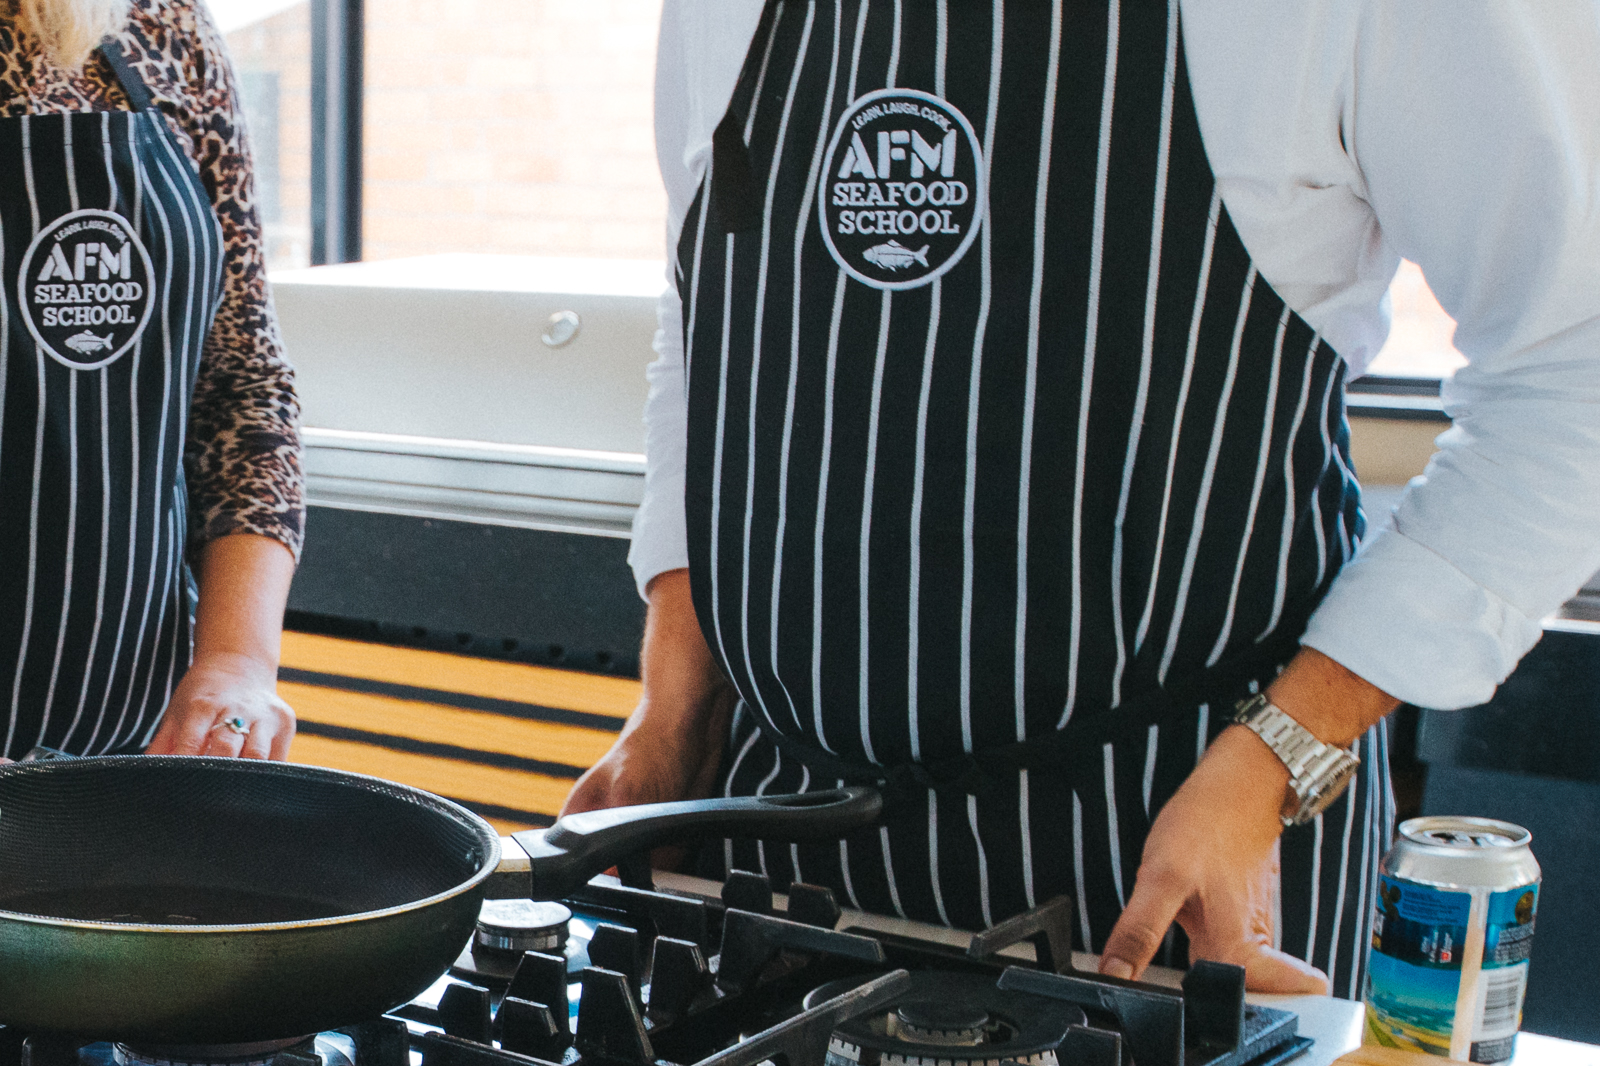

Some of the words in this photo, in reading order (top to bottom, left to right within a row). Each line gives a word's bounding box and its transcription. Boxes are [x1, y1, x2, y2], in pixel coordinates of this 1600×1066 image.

[838, 130, 957, 179] AFM
[832, 181, 968, 206] SEAFOOD
[838, 210, 960, 234] SCHOOL
[37, 242, 131, 281] AFM
[34, 282, 142, 303] SEAFOOD
[43, 305, 135, 326] SCHOOL
